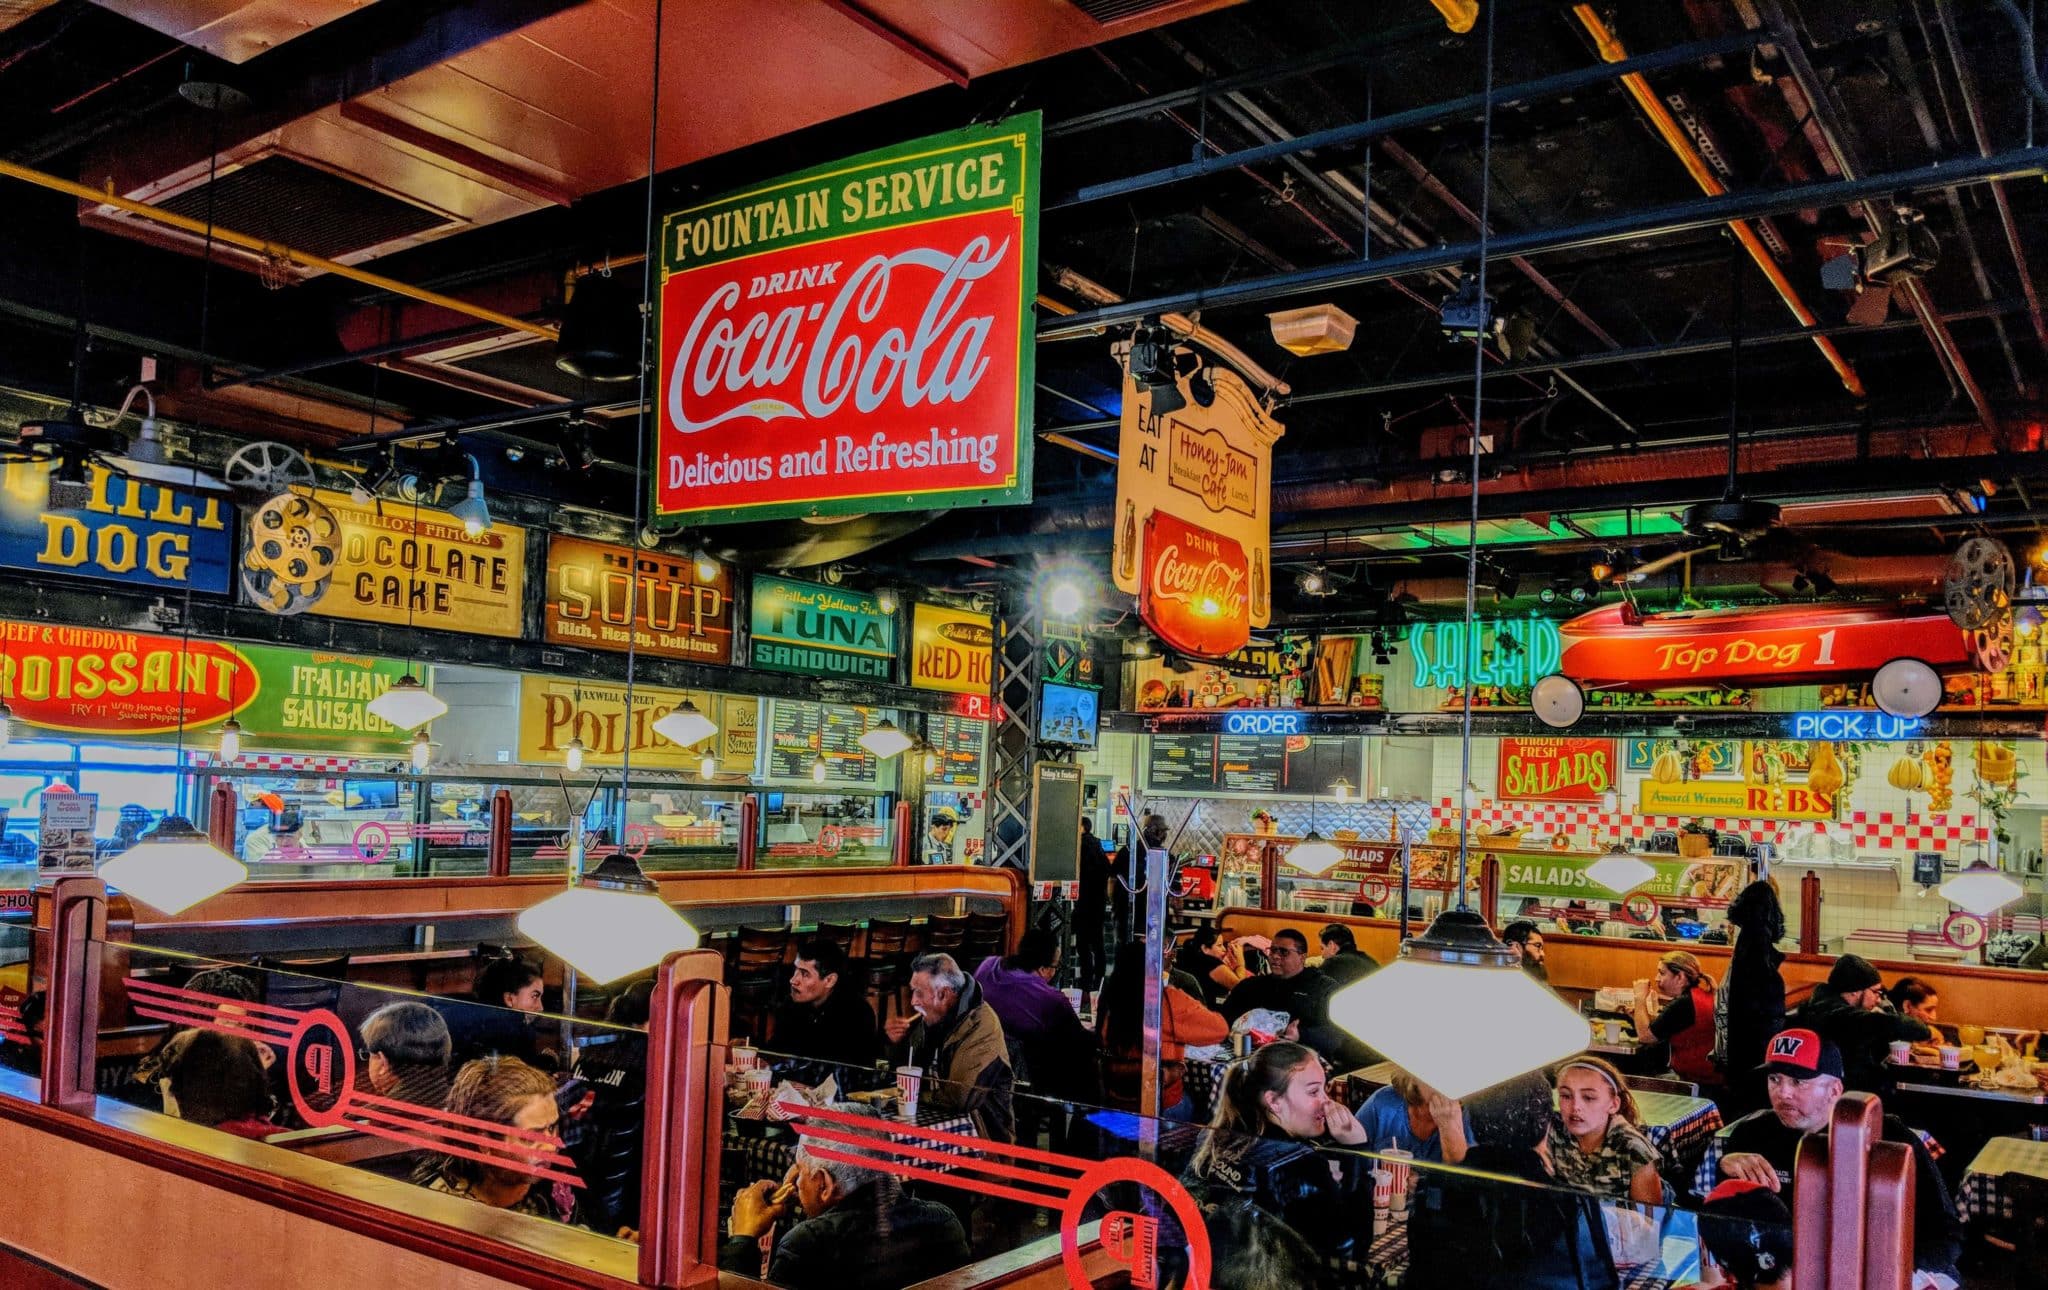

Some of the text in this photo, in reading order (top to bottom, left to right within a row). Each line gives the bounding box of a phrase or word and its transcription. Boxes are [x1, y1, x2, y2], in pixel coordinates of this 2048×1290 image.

[675, 152, 1005, 262] FOUNTAIN SERVICE
[747, 261, 844, 300] DRINK
[669, 234, 1011, 434] Coca-Cola
[1138, 403, 1164, 440] EAT
[669, 427, 999, 489] Delicious and Refreshing
[1138, 443, 1158, 475] AT
[1180, 431, 1247, 480] Honey-Jam
[36, 512, 190, 581] DOG
[1185, 532, 1219, 557] DRINK
[603, 553, 686, 577] HOT
[354, 572, 452, 616] CAKE
[558, 563, 722, 637] SOUP
[816, 593, 858, 613] Yellow
[42, 627, 55, 645] &
[58, 627, 138, 652] CHEDDAR
[557, 620, 598, 640] Rich,
[660, 634, 719, 654] Delicious
[771, 607, 887, 650] TUNA
[756, 643, 889, 678] SANDWICH
[918, 641, 962, 680] RED
[1410, 616, 1561, 689] SALAD
[1655, 629, 1836, 674] Top Dog 1
[291, 665, 391, 701] ITALIAN
[574, 689, 621, 703] MAXWELL
[70, 703, 92, 716] TRY
[97, 704, 108, 717] IT
[1227, 713, 1299, 734] ORDER
[1796, 715, 1919, 740] PICK UP
[1520, 746, 1558, 758] FRESH
[1506, 750, 1608, 796] SALADS
[1652, 790, 1690, 805] Award
[1509, 865, 1587, 888] SALADS
[1772, 1036, 1803, 1057] W
